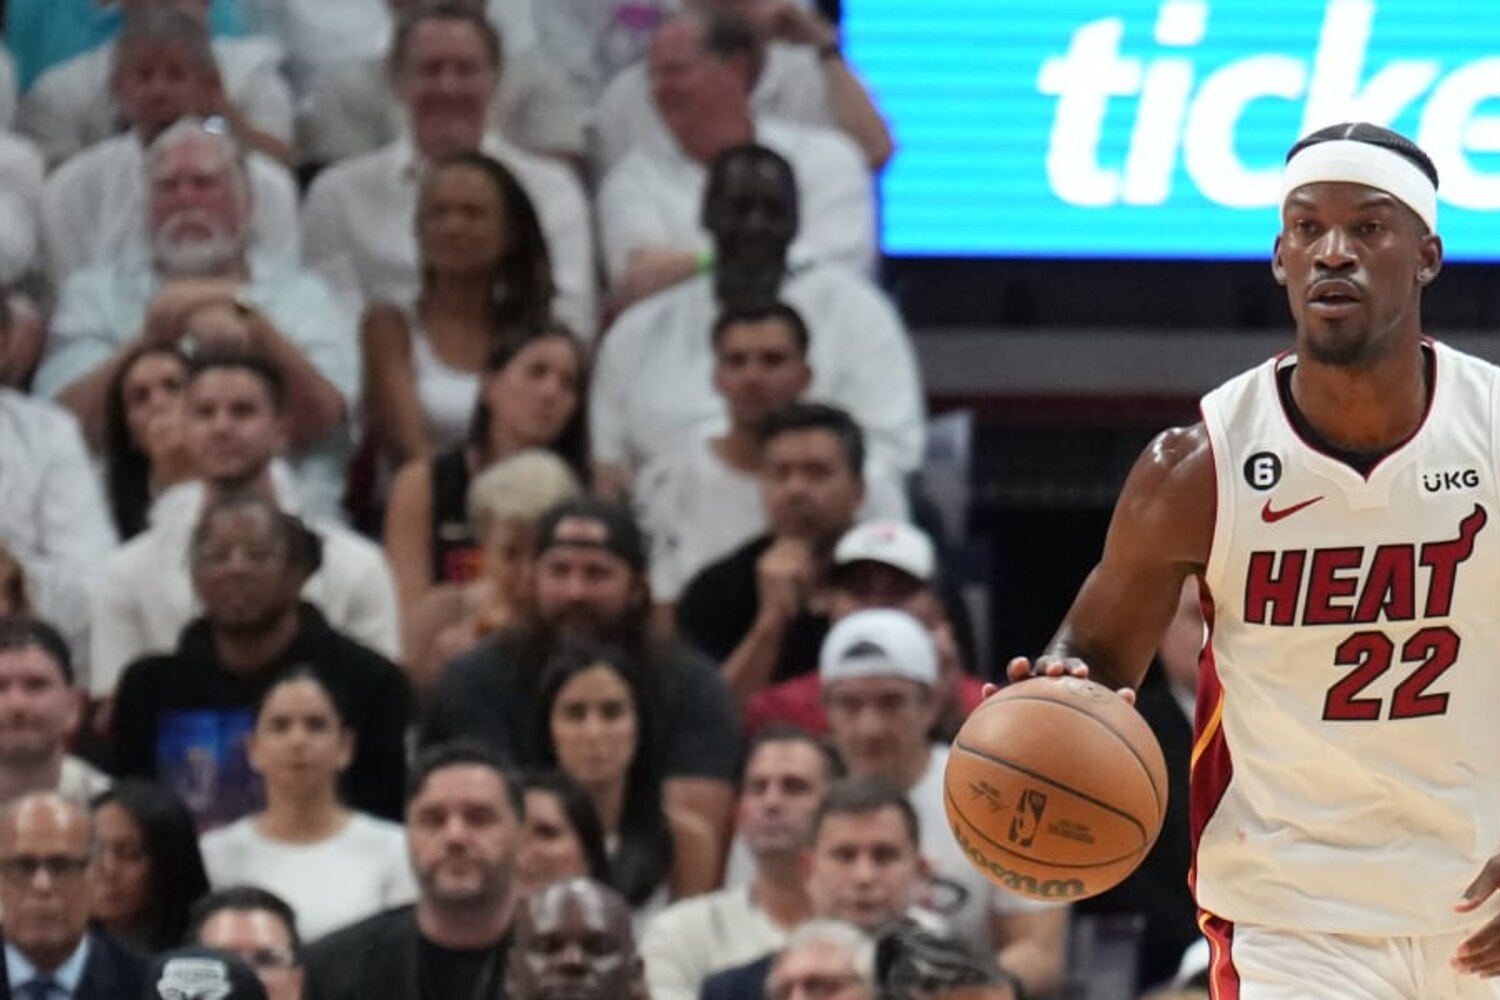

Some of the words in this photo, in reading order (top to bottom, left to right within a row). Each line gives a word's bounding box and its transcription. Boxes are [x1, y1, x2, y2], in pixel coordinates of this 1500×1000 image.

[1253, 457, 1275, 487] 6
[1423, 469, 1480, 493] UKG
[1243, 502, 1488, 627] HEAT
[1322, 625, 1462, 721] 22
